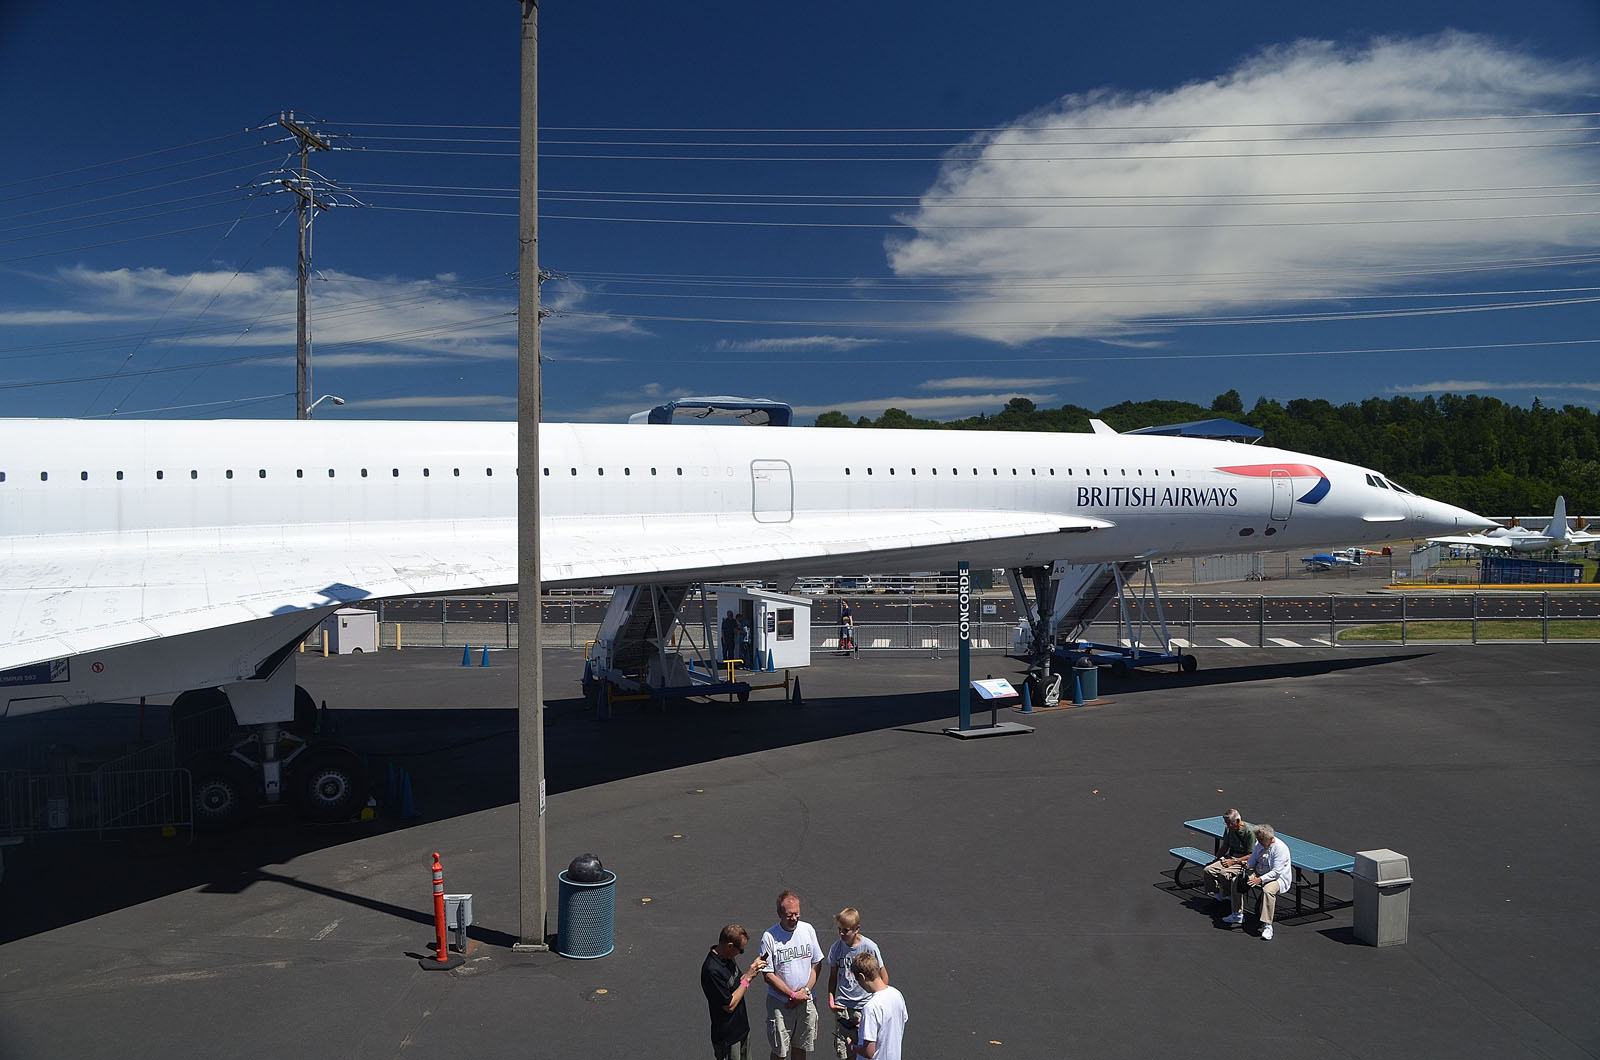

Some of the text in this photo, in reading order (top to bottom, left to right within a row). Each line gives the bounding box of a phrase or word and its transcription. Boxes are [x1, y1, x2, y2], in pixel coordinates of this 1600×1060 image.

[1076, 486, 1238, 507] BRITISH AIRWAYS
[960, 568, 969, 640] CONCORDE
[776, 944, 813, 962] ITALIA
